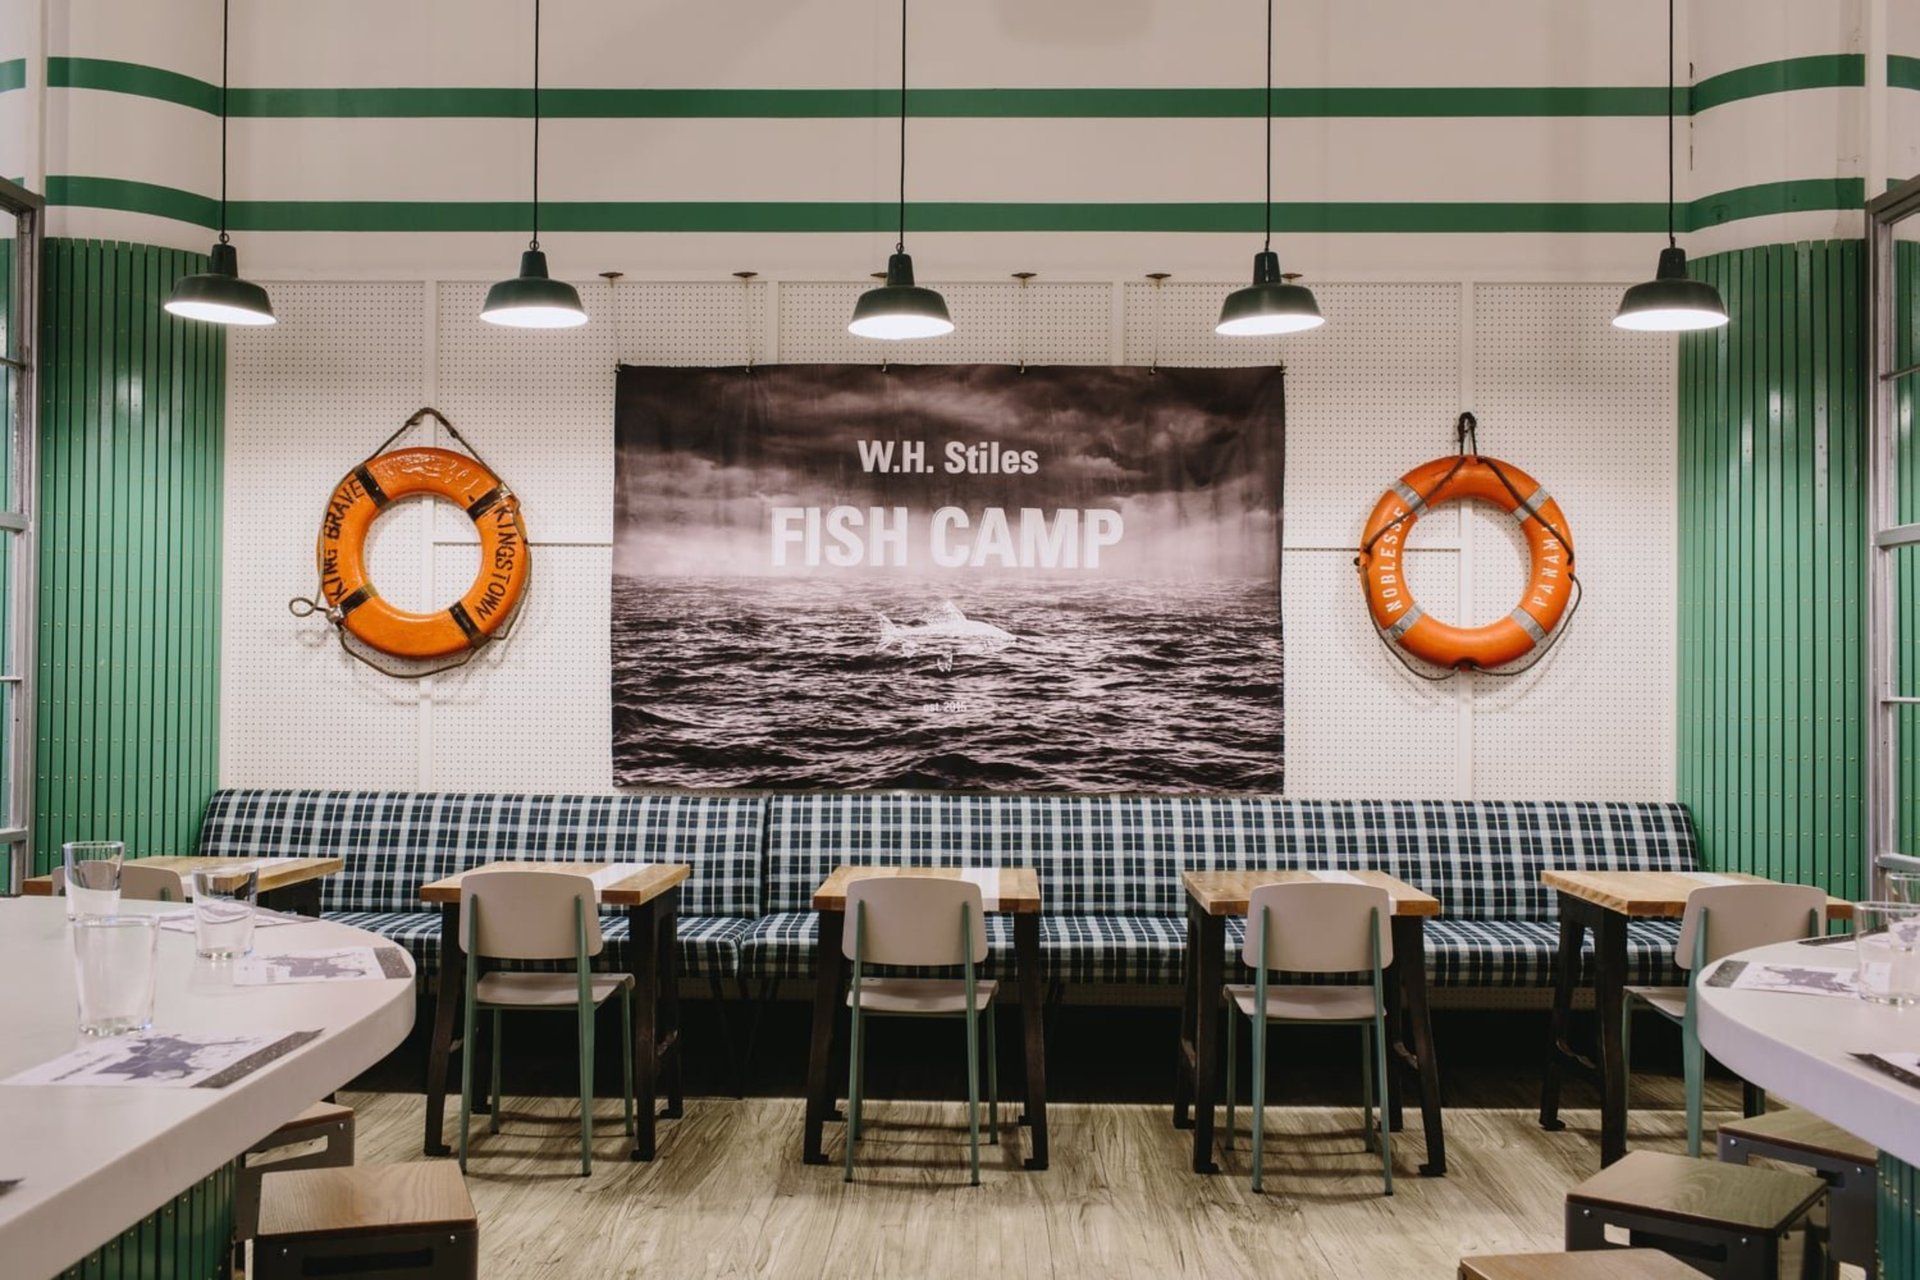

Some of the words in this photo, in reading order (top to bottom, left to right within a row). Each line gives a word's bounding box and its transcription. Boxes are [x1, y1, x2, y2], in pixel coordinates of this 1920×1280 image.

[857, 440, 934, 474] W.H.
[944, 441, 1039, 475] Stiles
[323, 480, 364, 541] BRAVE
[771, 506, 908, 567] FISH
[930, 506, 1124, 569] CAMP
[322, 549, 348, 601] KING
[477, 505, 516, 621] KINGSTOWN
[923, 703, 942, 712] est.
